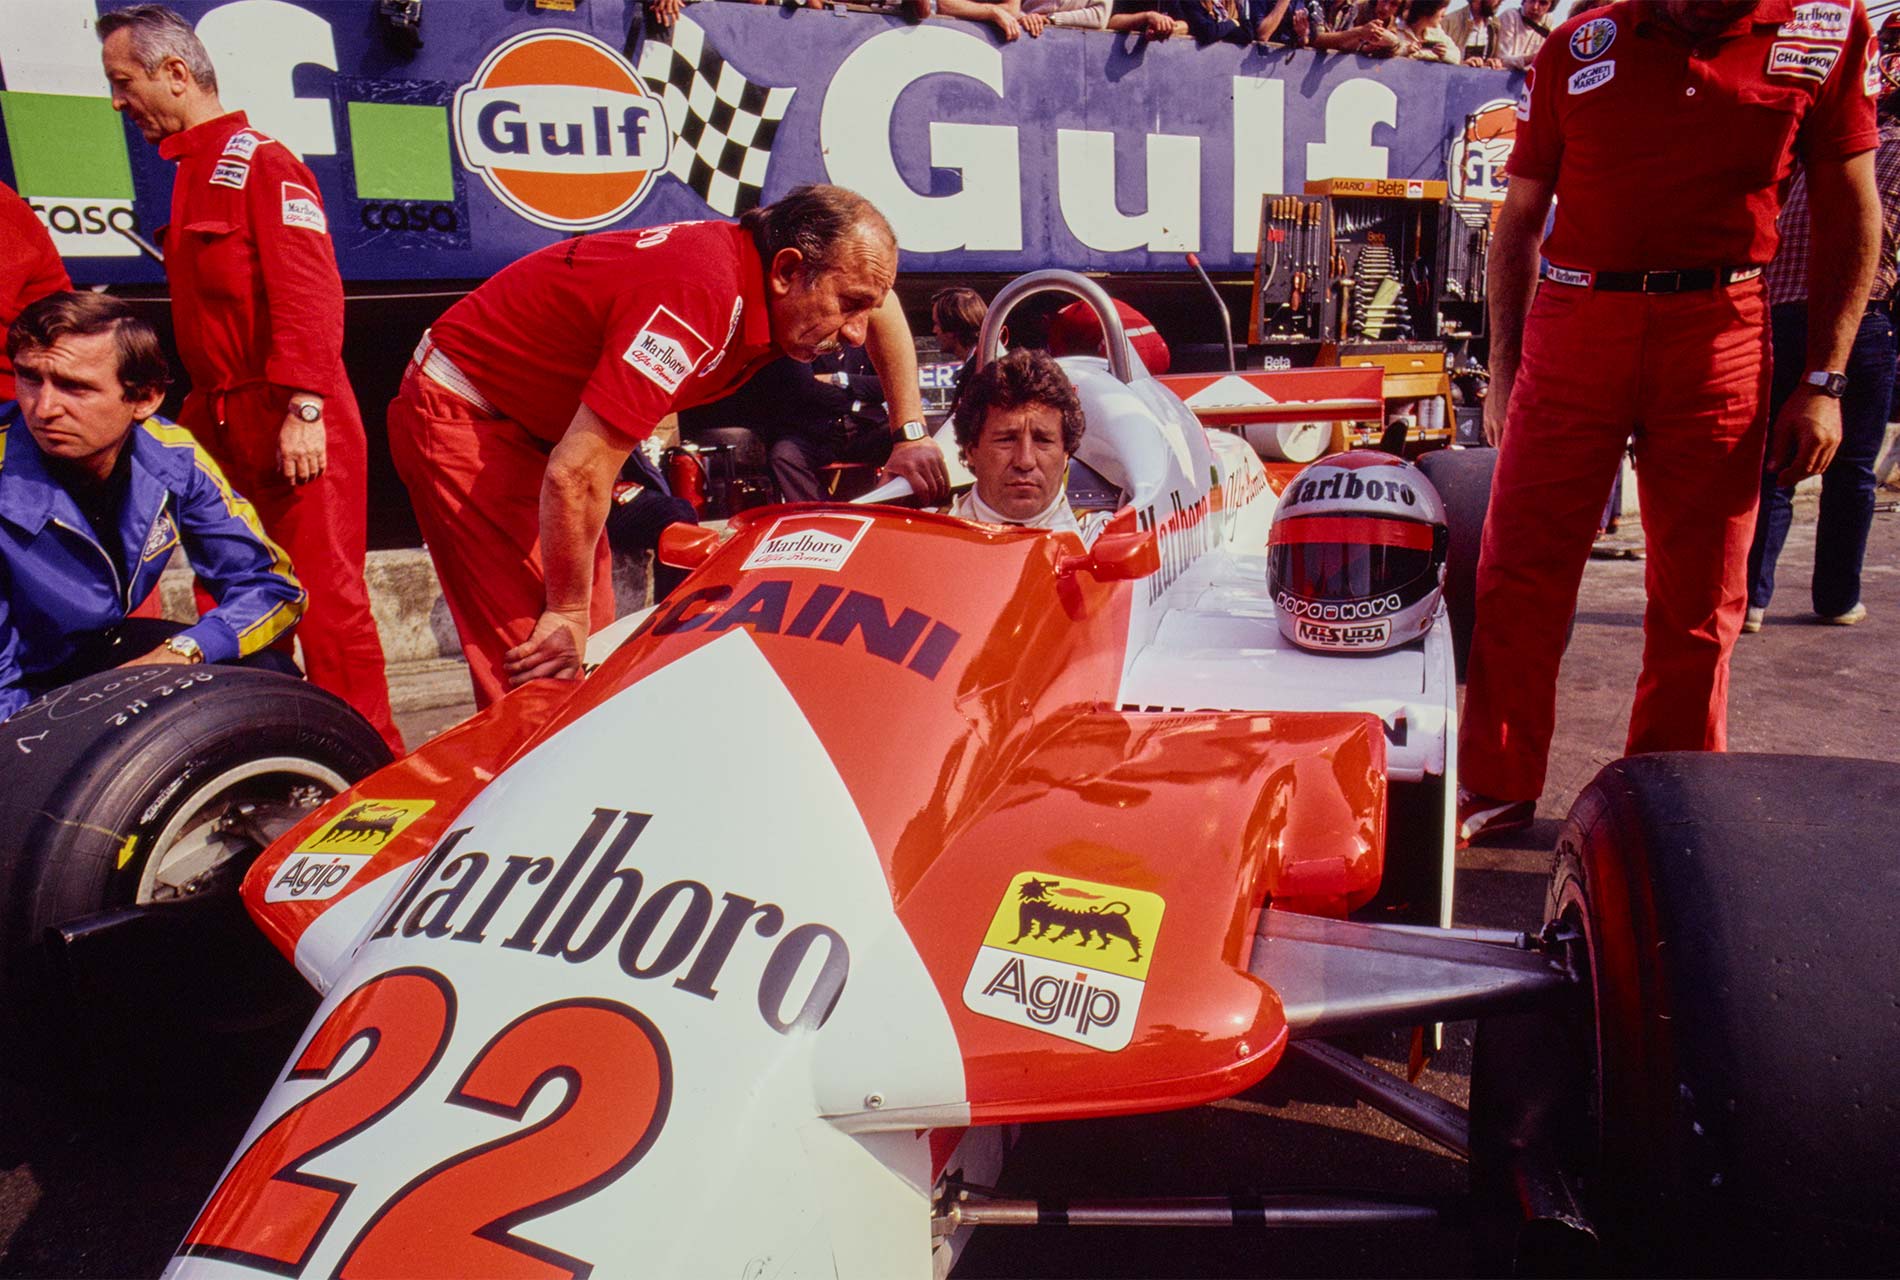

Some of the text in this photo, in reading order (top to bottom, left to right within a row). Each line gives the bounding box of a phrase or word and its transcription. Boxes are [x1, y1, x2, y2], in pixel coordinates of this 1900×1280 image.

[1776, 52, 1832, 68] CHAMPION
[477, 100, 650, 157] Gulf
[820, 24, 1398, 254] Gulf
[1376, 180, 1405, 196] Beta
[361, 203, 457, 232] casa
[632, 350, 651, 368] Alfa
[640, 335, 686, 375] Marlboro
[1264, 356, 1291, 370] Beta
[1282, 473, 1416, 509] Marlboro
[763, 535, 842, 553] Marlboro
[275, 857, 351, 897] Agip
[981, 957, 1121, 1036] Agip
[174, 966, 674, 1280] 22
